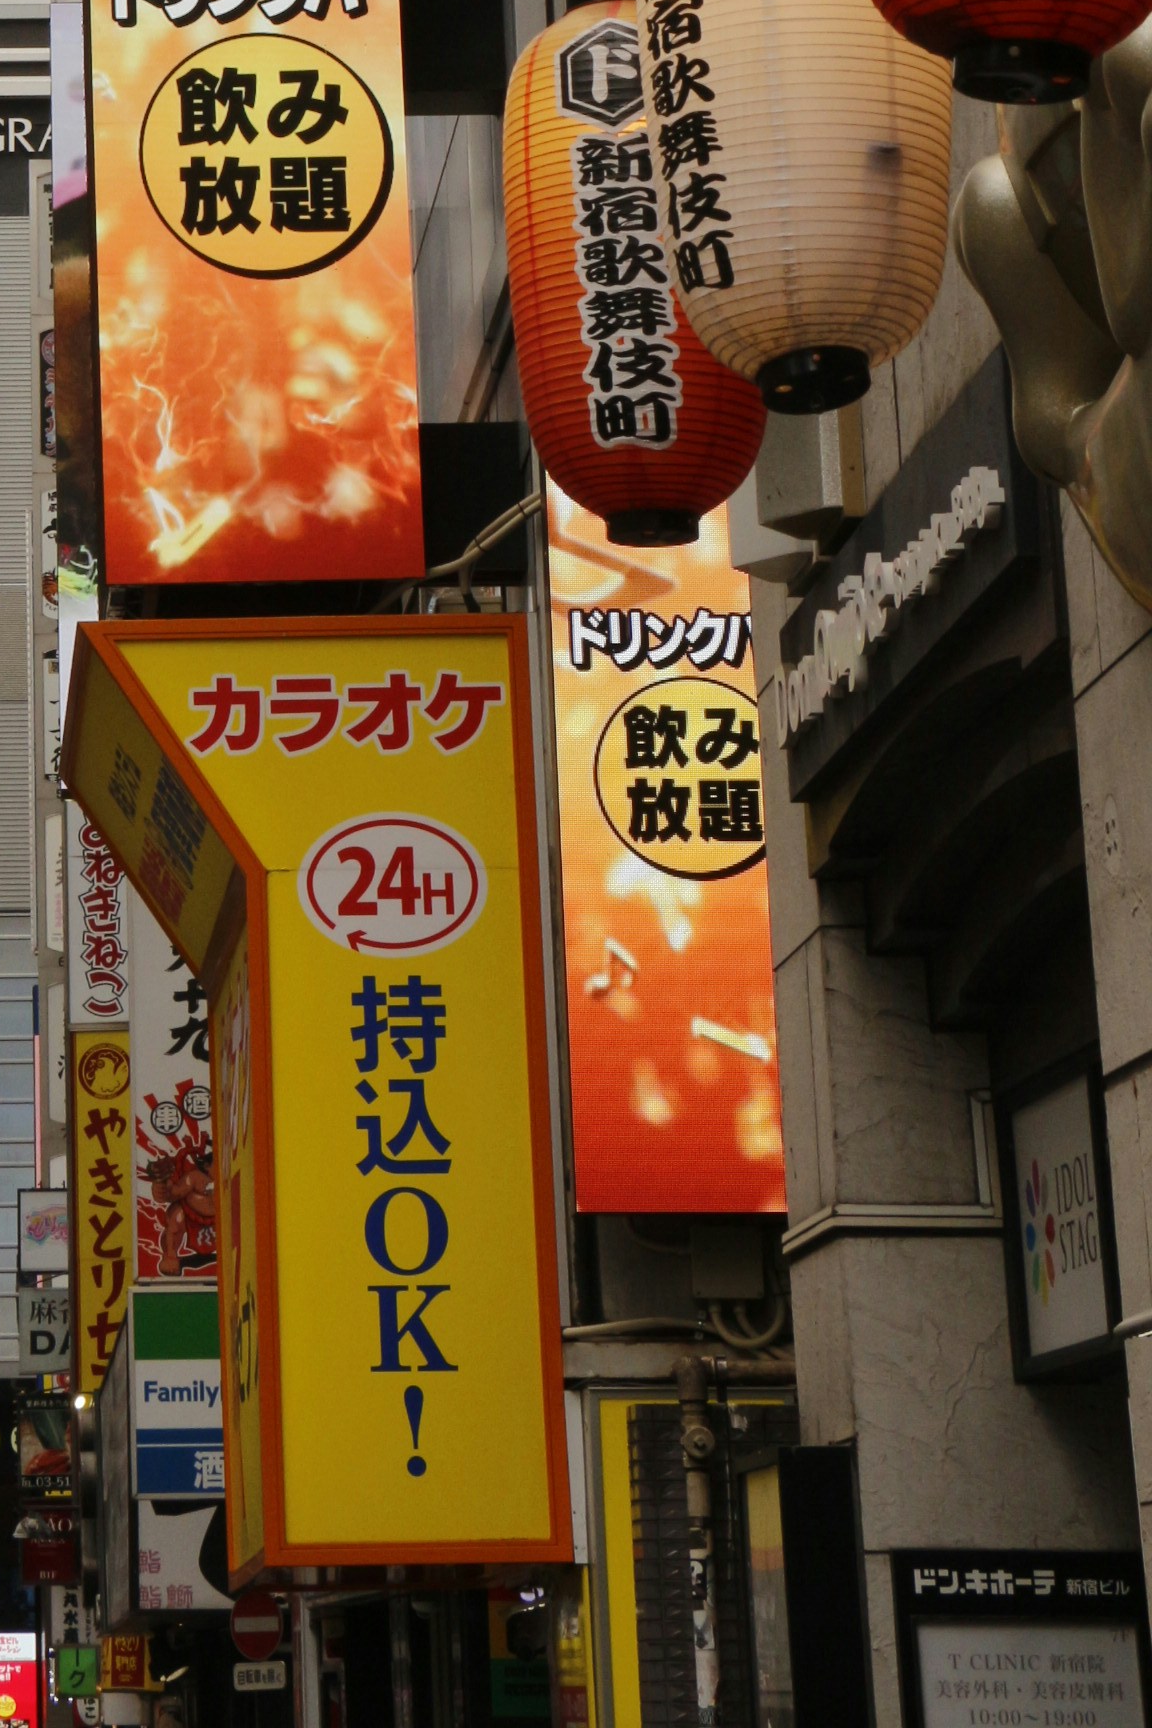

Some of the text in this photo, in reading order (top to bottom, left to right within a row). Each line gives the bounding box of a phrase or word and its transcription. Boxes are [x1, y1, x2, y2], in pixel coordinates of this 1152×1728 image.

[177, 67, 349, 147] 飲み
[180, 156, 351, 236] 放題
[579, 133, 674, 443] 新宿歌舞伎町
[189, 673, 503, 755] カラオケ
[623, 704, 759, 770] 飲み
[625, 778, 764, 843] 放題
[336, 846, 455, 917] 24H
[157, 1106, 178, 1131] 串
[1054, 1152, 1095, 1216] IDOL
[84, 1106, 130, 1376] やきとりセ
[144, 1379, 219, 1408] Family
[1066, 1578, 1130, 1597] 新宿ビル
[970, 1654, 1041, 1671] CLINIC
